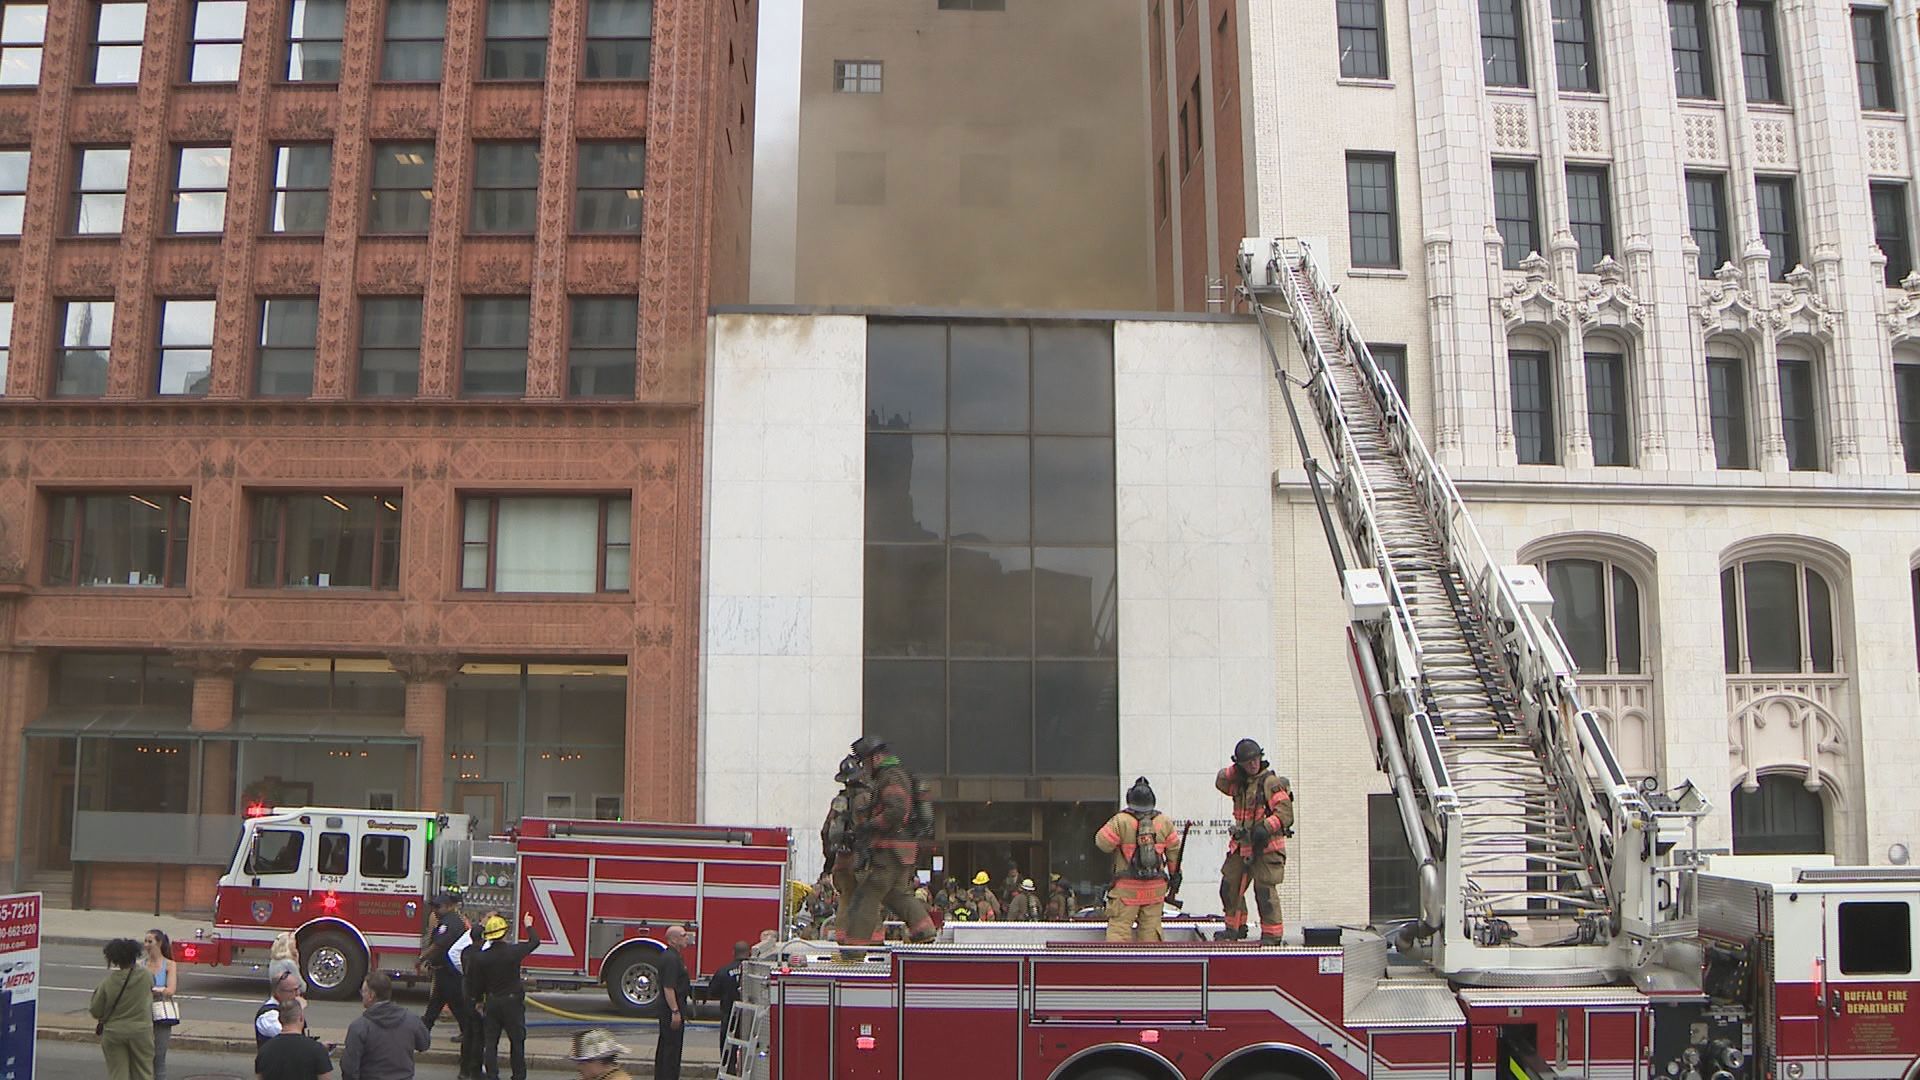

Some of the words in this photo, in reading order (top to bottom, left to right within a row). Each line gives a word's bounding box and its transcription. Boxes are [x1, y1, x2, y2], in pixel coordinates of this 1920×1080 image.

[320, 875, 343, 884] F-347
[0, 901, 35, 921] 5-7211
[1844, 991, 1883, 1000] BUFFALO
[1887, 990, 1908, 1000] FIRE
[1847, 1003, 1905, 1013] DEPARTMENT
